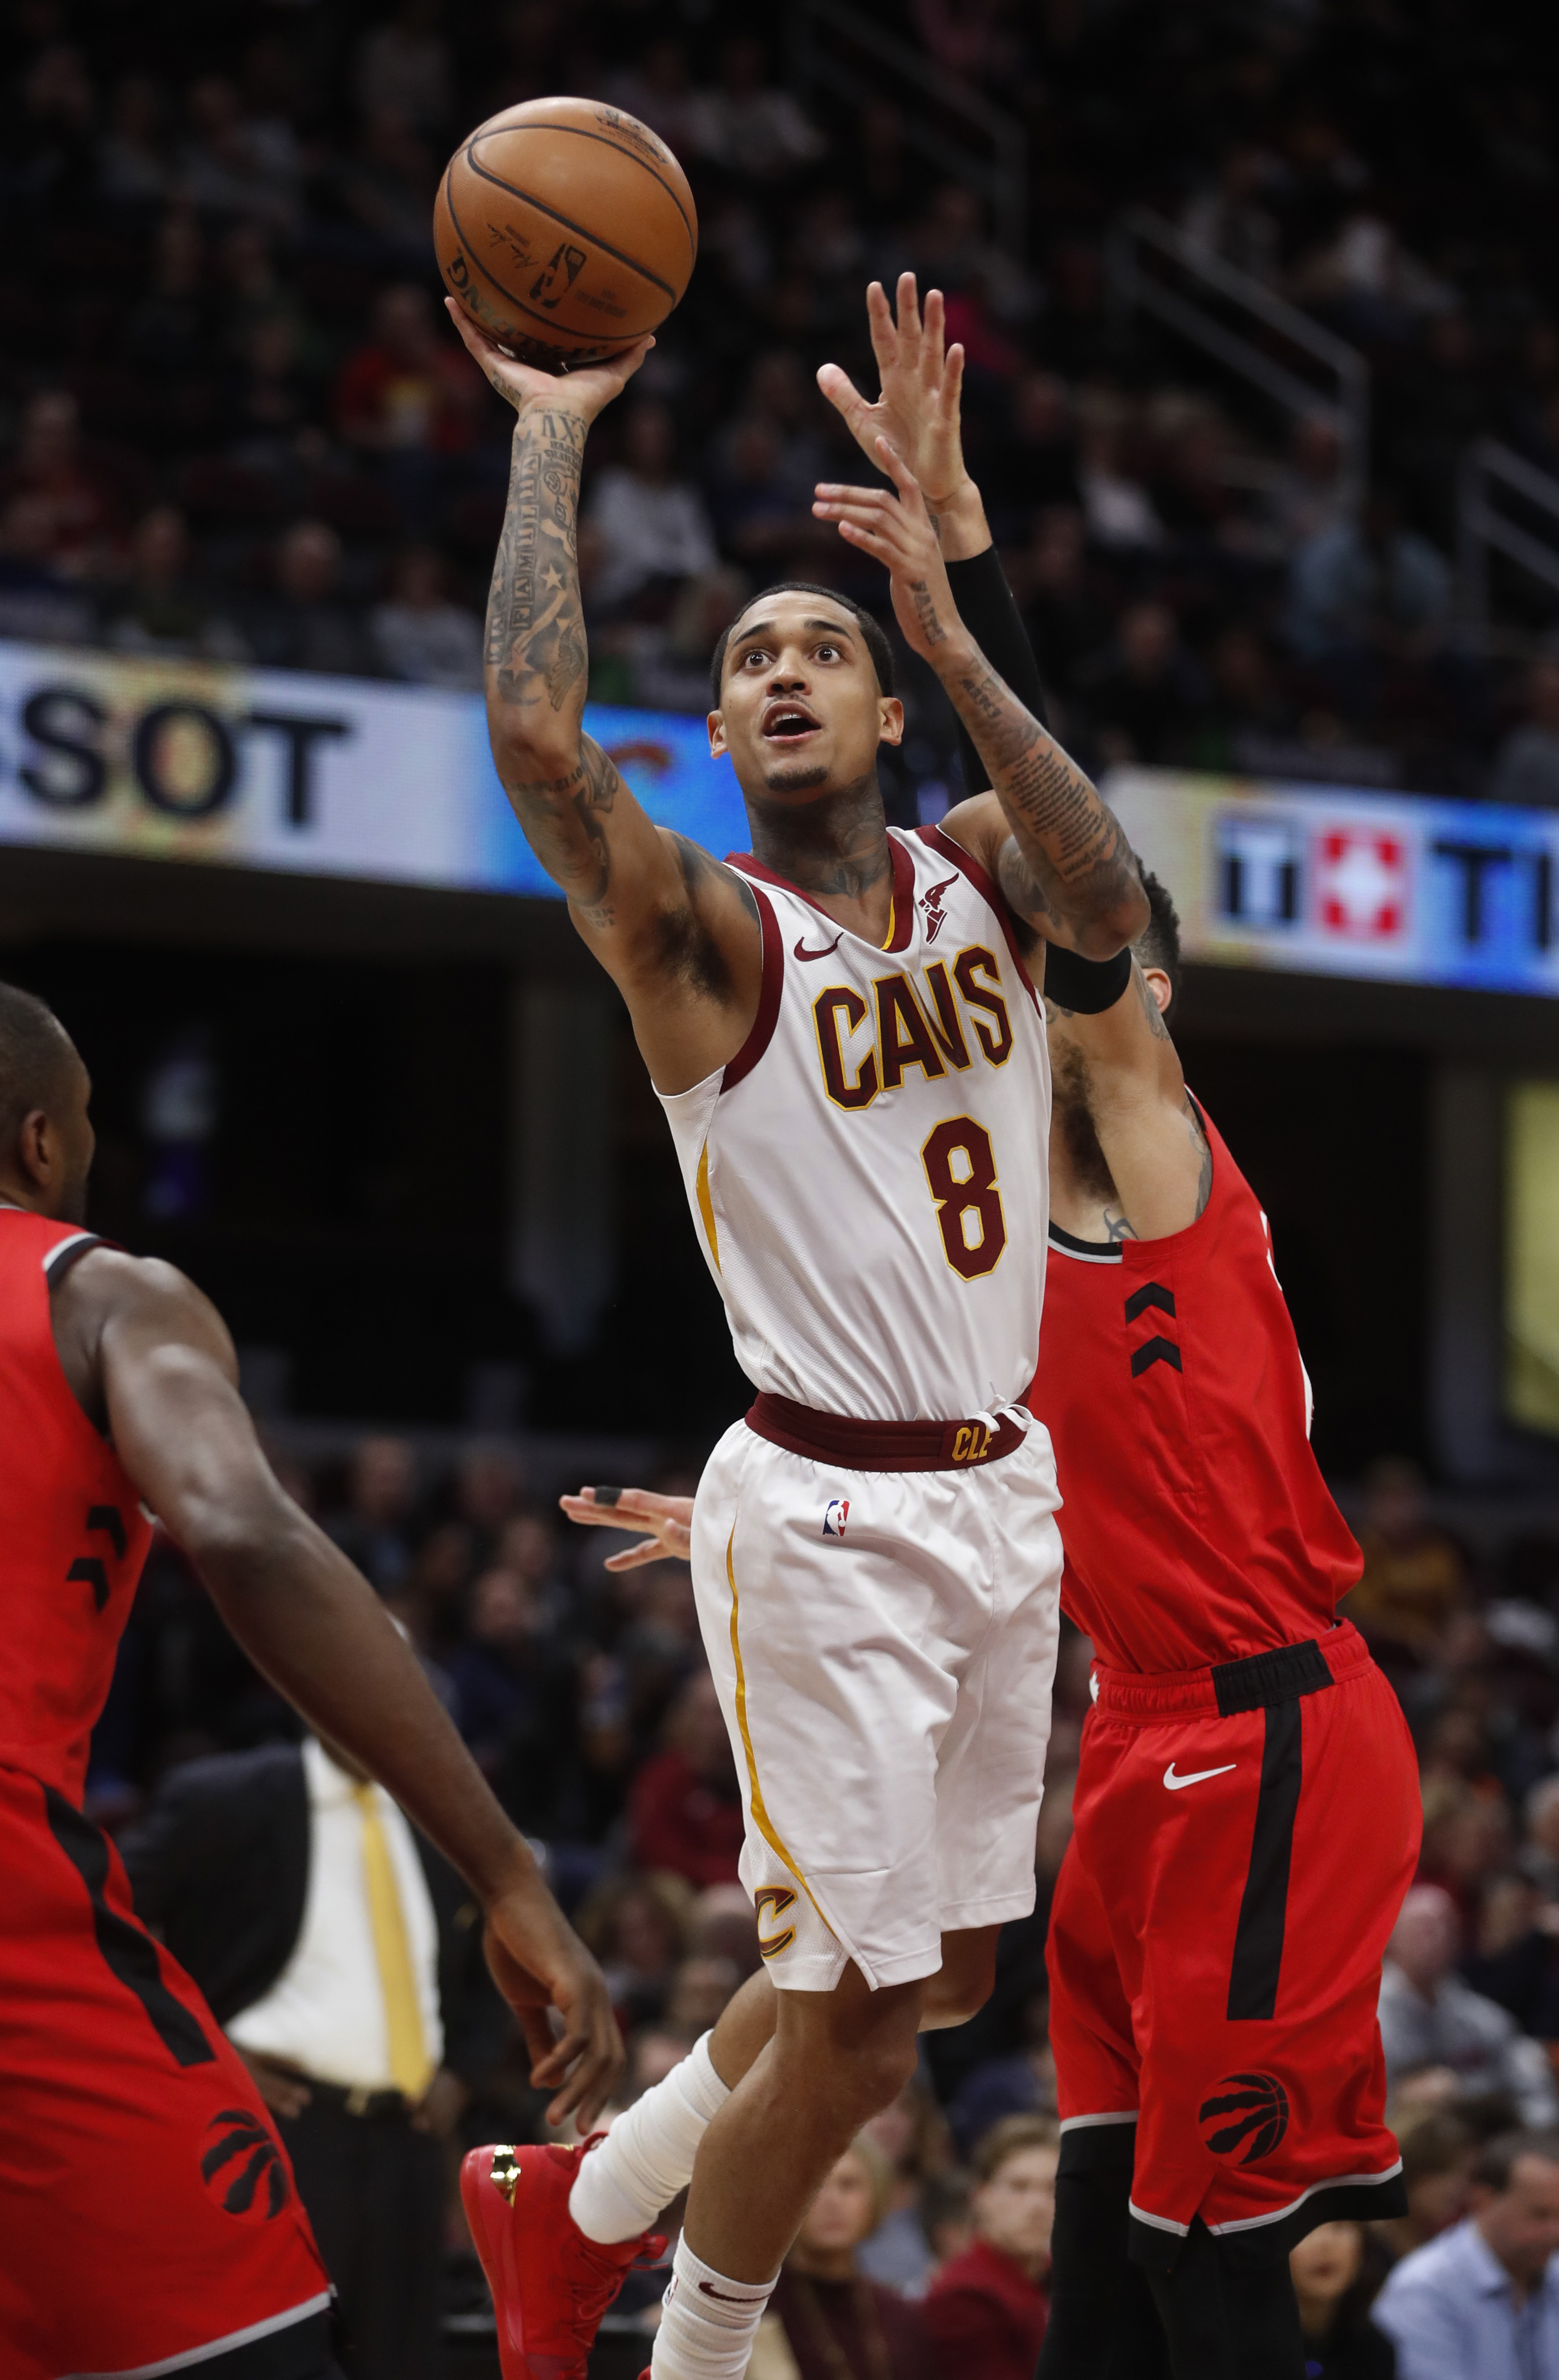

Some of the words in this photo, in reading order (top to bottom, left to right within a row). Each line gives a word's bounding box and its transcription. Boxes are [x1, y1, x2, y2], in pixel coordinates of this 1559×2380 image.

[18, 685, 354, 831] SOT
[1434, 840, 1551, 954] TI
[811, 943, 1014, 1112] CAVS
[920, 1114, 1008, 1283] 8
[952, 1426, 993, 1462] CLE
